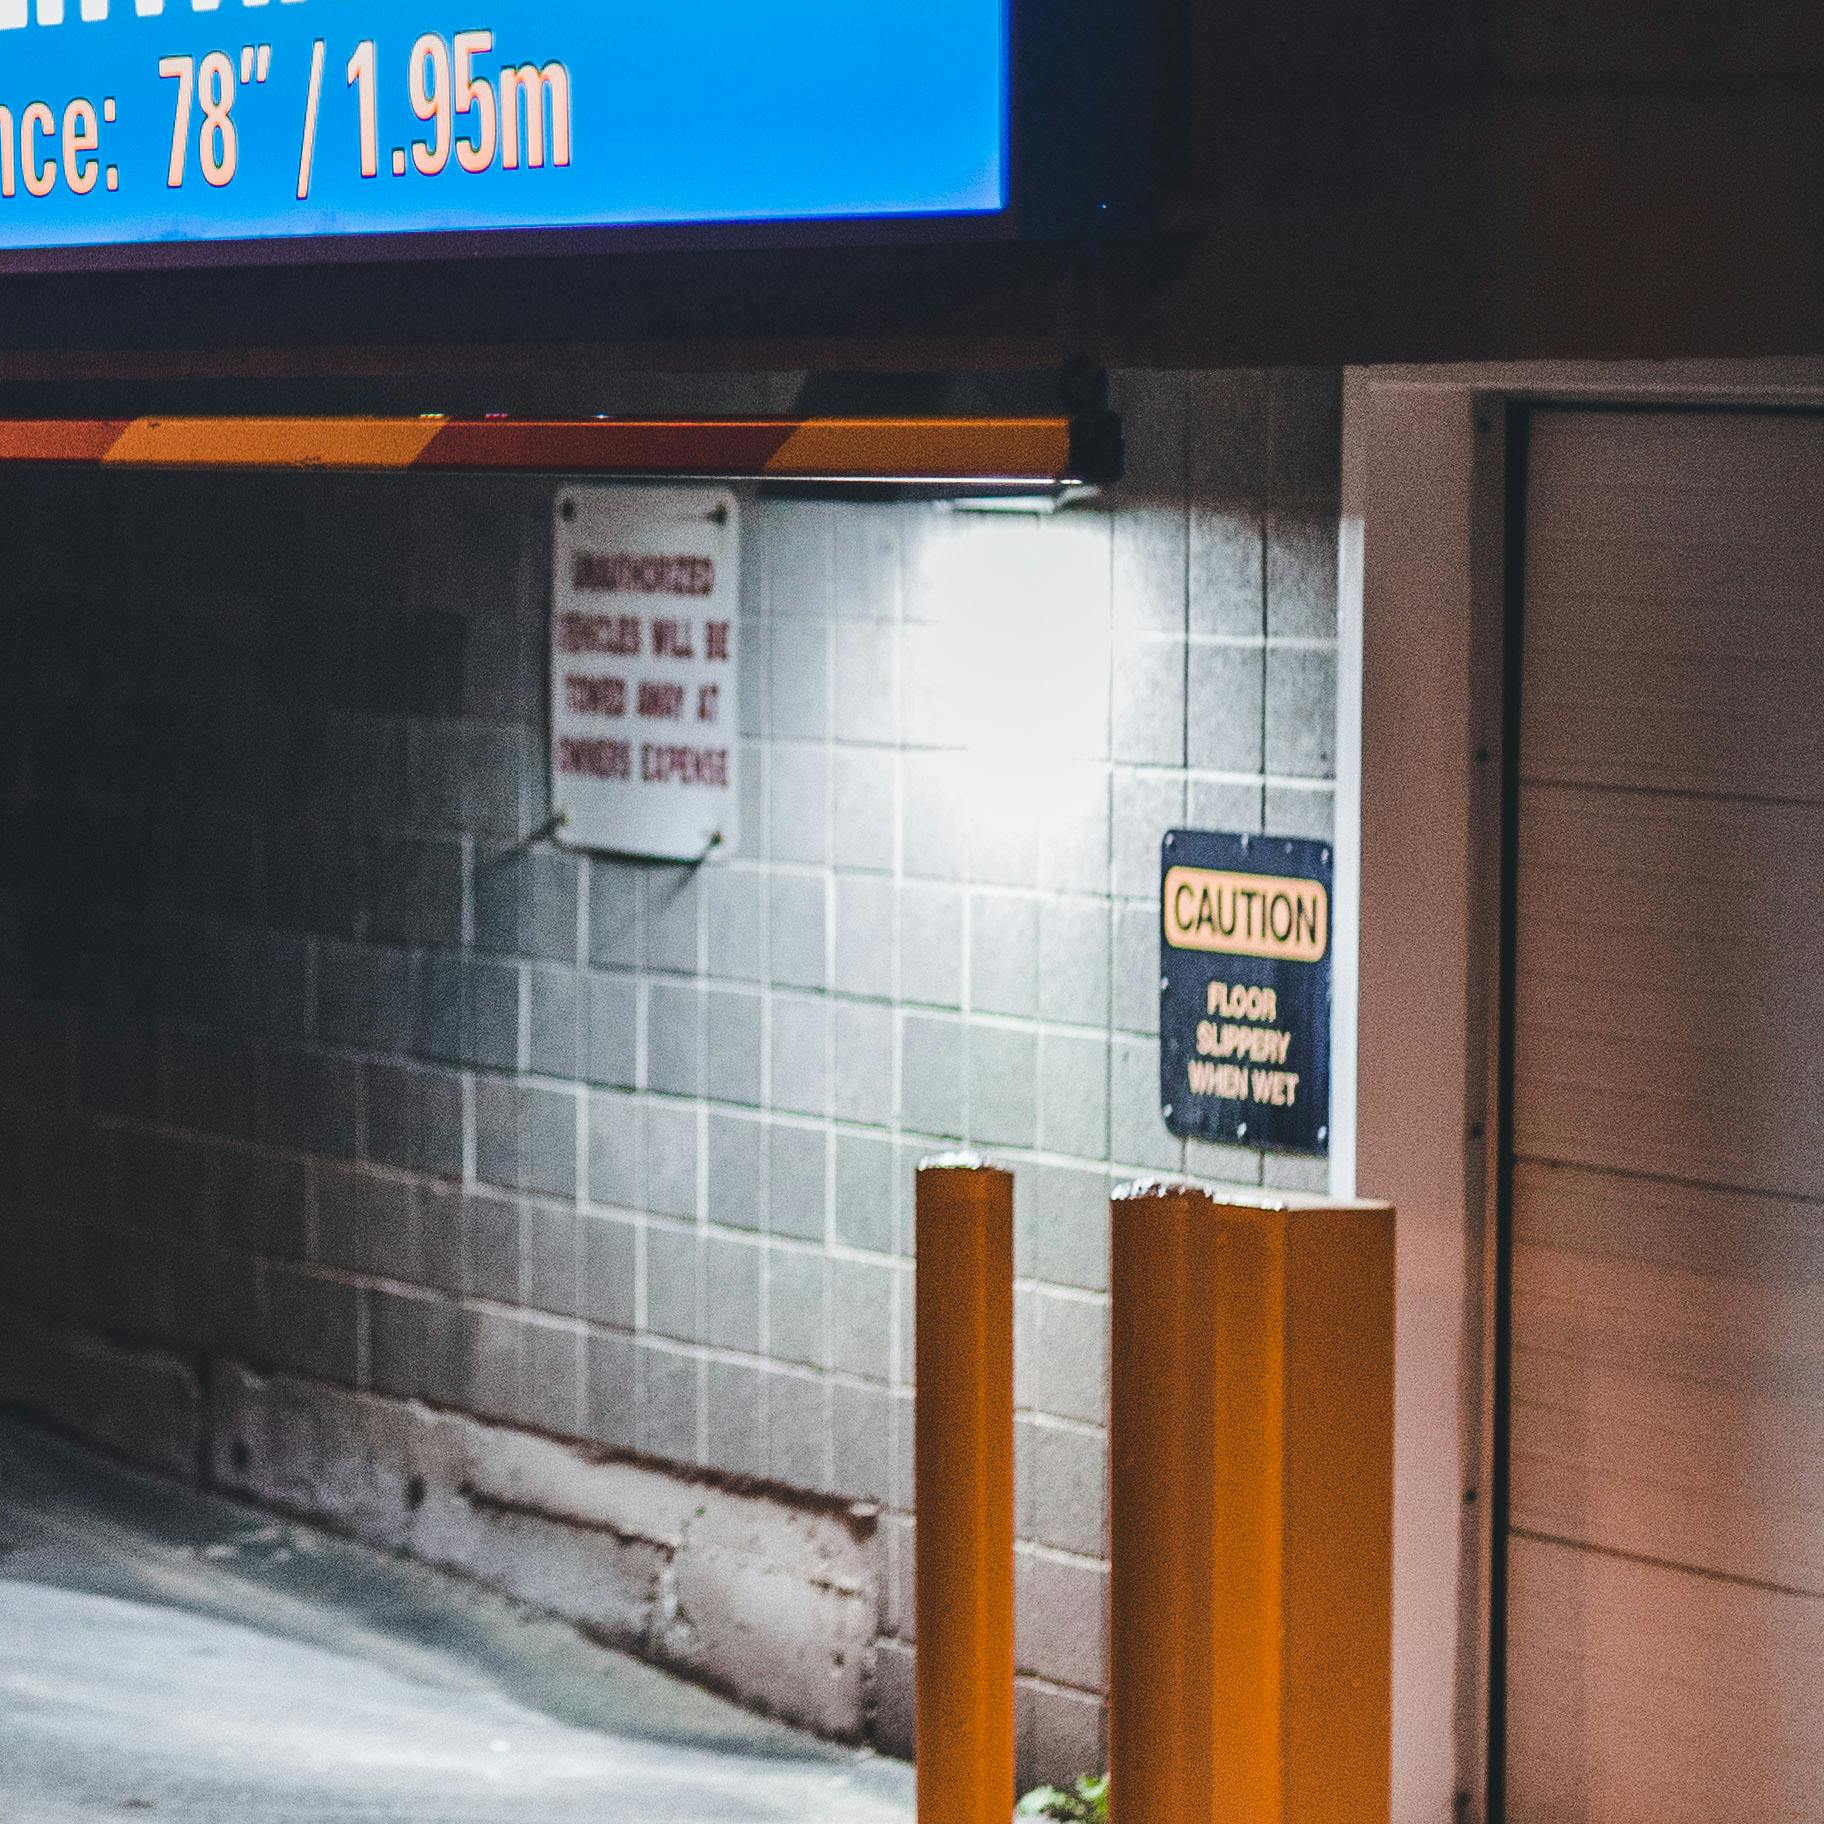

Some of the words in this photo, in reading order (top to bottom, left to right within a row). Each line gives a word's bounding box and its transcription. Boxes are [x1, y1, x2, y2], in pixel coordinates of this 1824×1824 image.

[346, 29, 572, 179] 1.95m
[1174, 883, 1318, 945] CAUTION
[1207, 980, 1277, 1023] FLOOR
[1196, 1020, 1291, 1065] SLIPPERY
[1187, 1060, 1249, 1102] WHEN
[1251, 1070, 1300, 1107] WET
